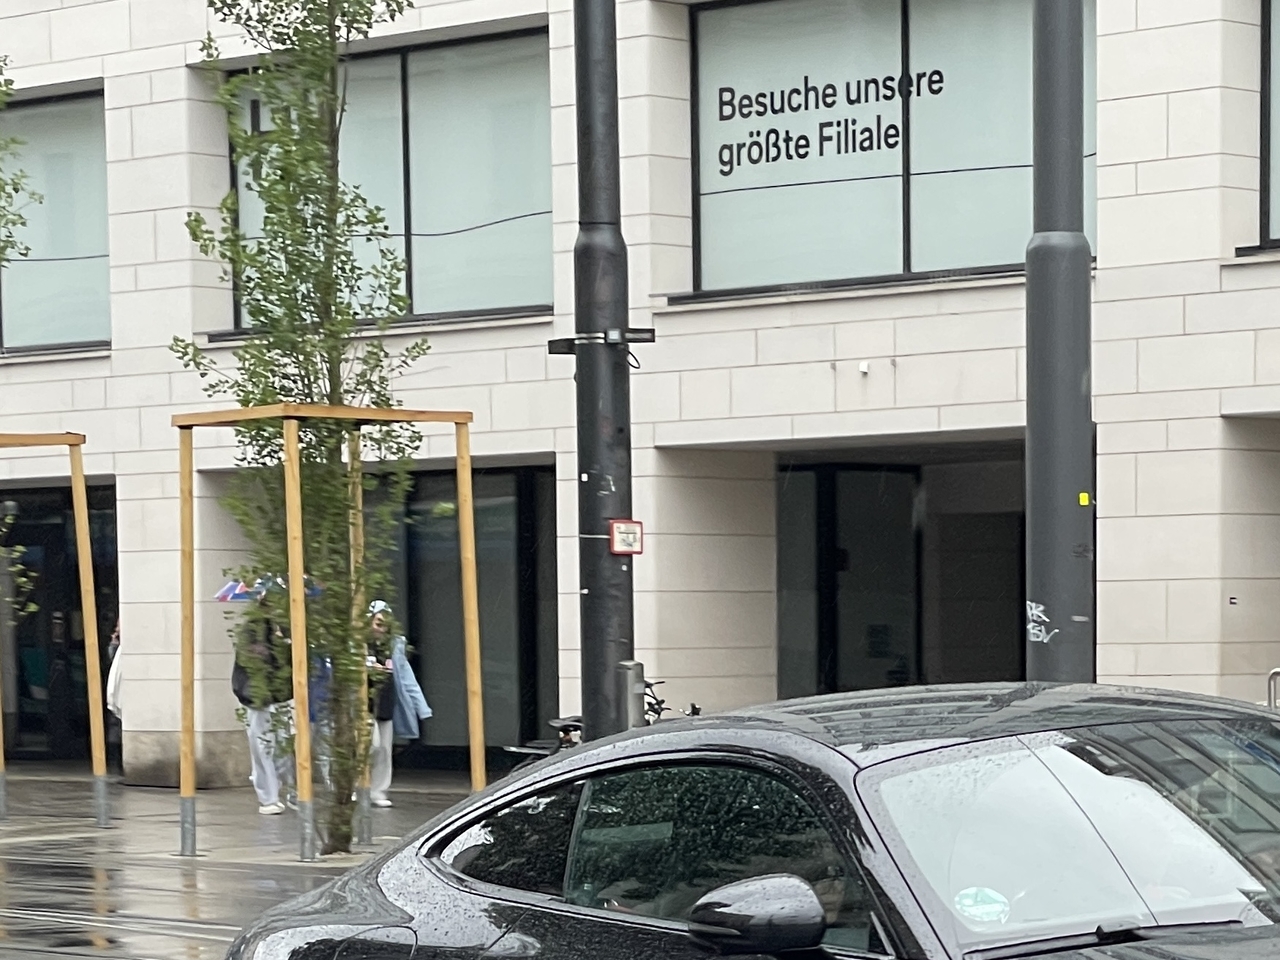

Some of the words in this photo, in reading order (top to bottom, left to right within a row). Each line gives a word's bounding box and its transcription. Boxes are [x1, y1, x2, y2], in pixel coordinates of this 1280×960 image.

[718, 75, 837, 121] Besuche
[718, 128, 810, 176] größte
[818, 114, 900, 157] Filiale
